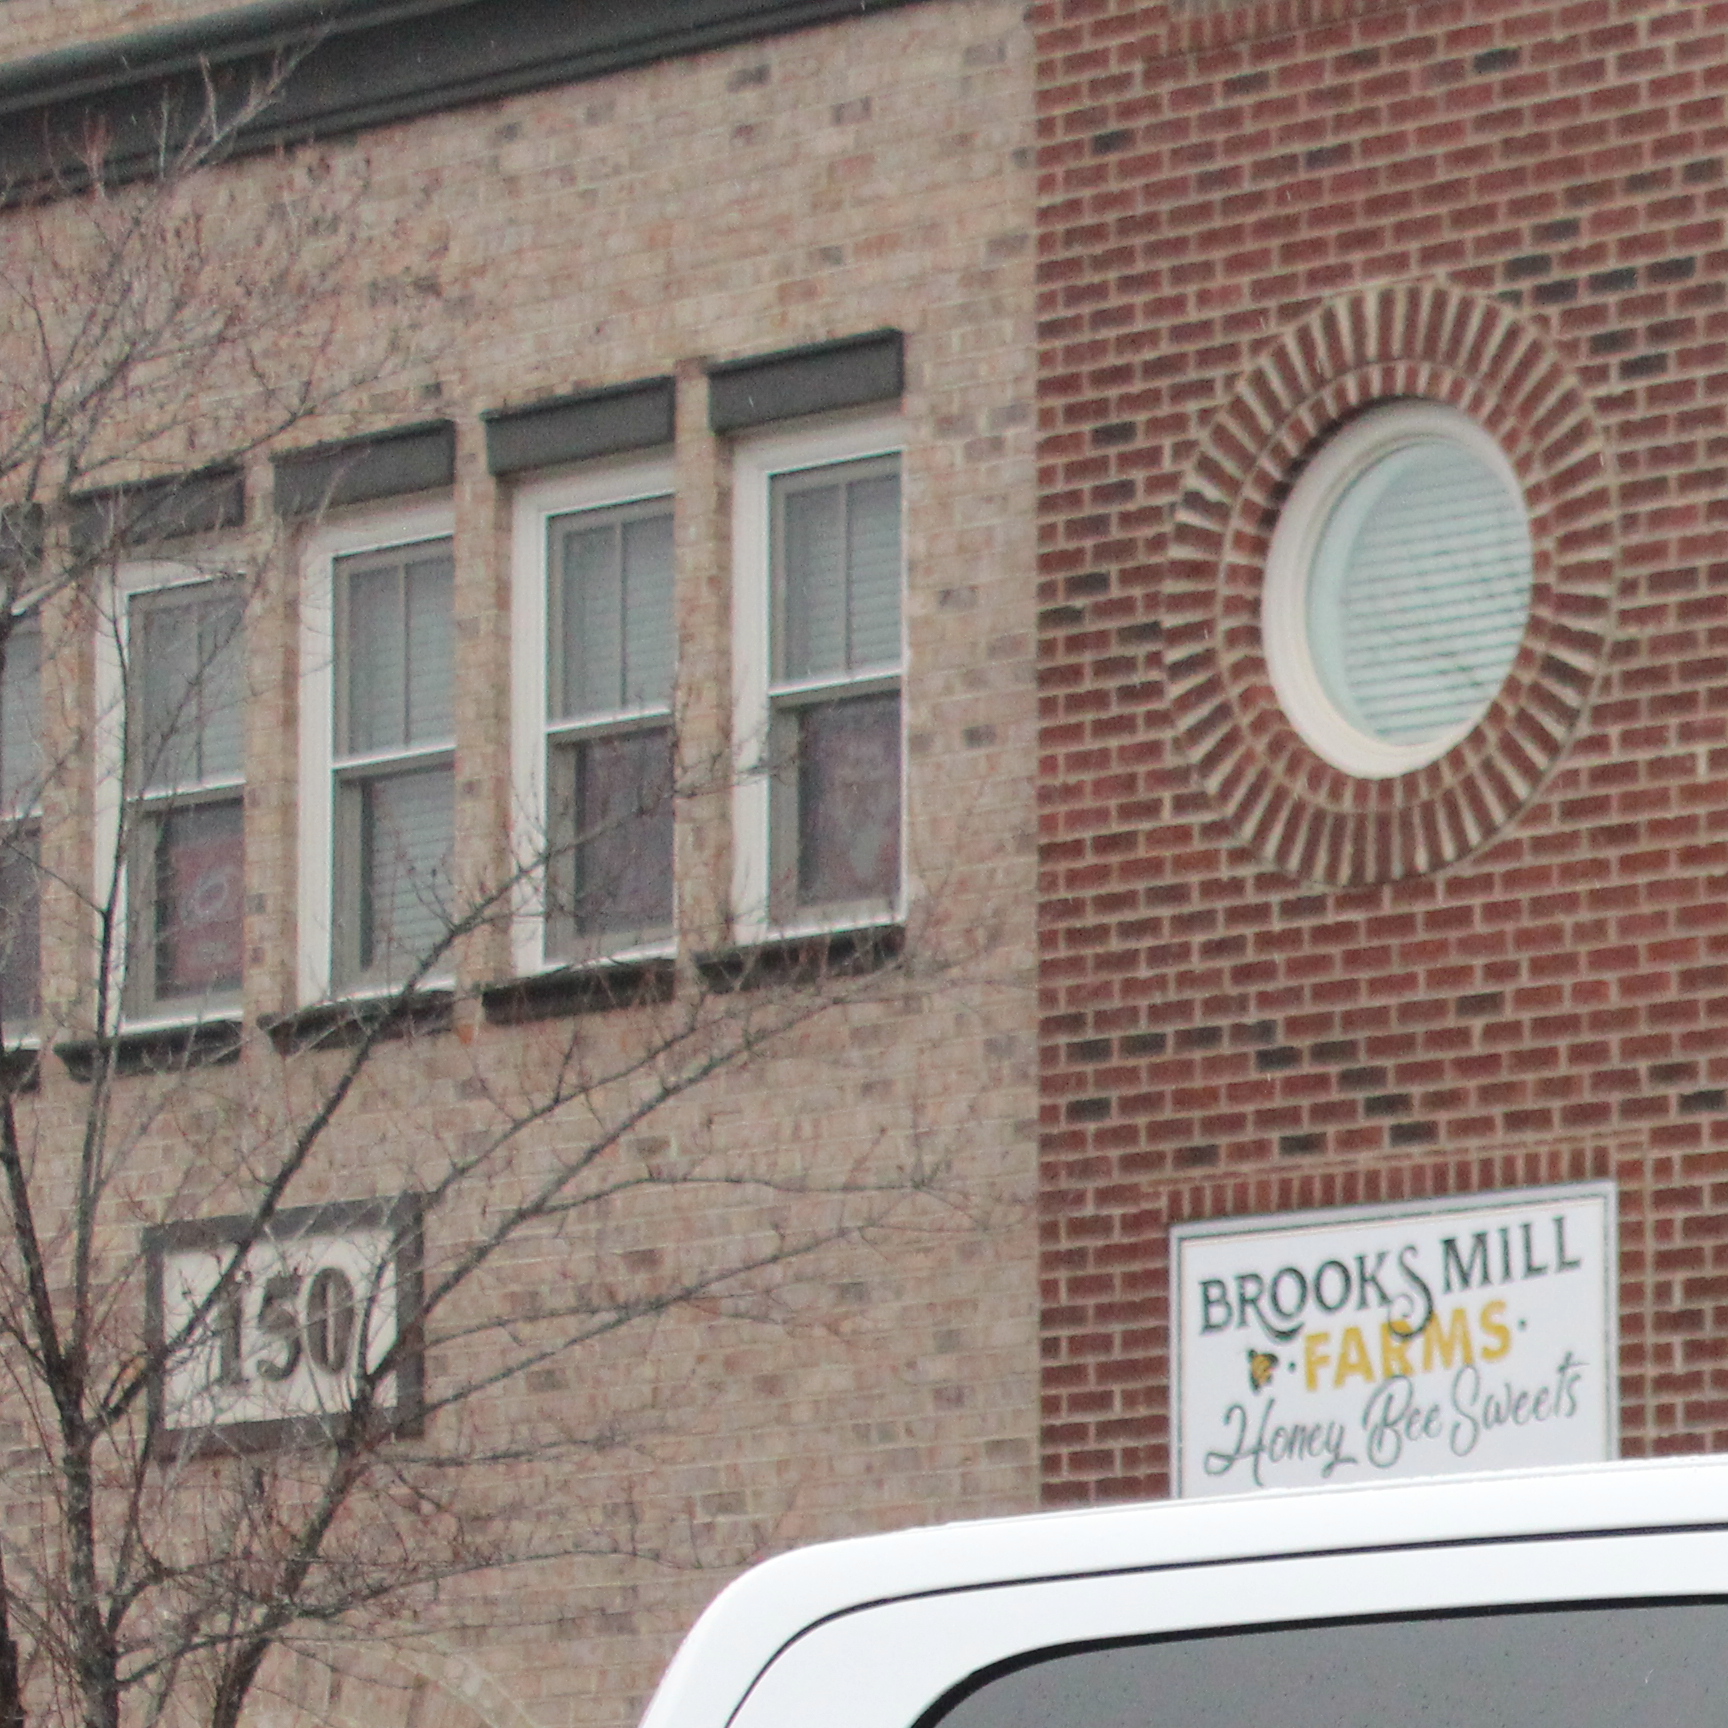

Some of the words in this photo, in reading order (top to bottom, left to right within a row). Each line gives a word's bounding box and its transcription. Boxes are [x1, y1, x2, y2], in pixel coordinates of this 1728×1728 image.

[206, 1266, 353, 1386] 150
[1199, 1244, 1433, 1340] BROOKS
[1441, 1215, 1583, 1295] MILL
[1304, 1299, 1513, 1393] FARMS
[1204, 1397, 1358, 1487] Honey
[1361, 1373, 1443, 1470] Bee
[1449, 1351, 1590, 1457] Sweets
